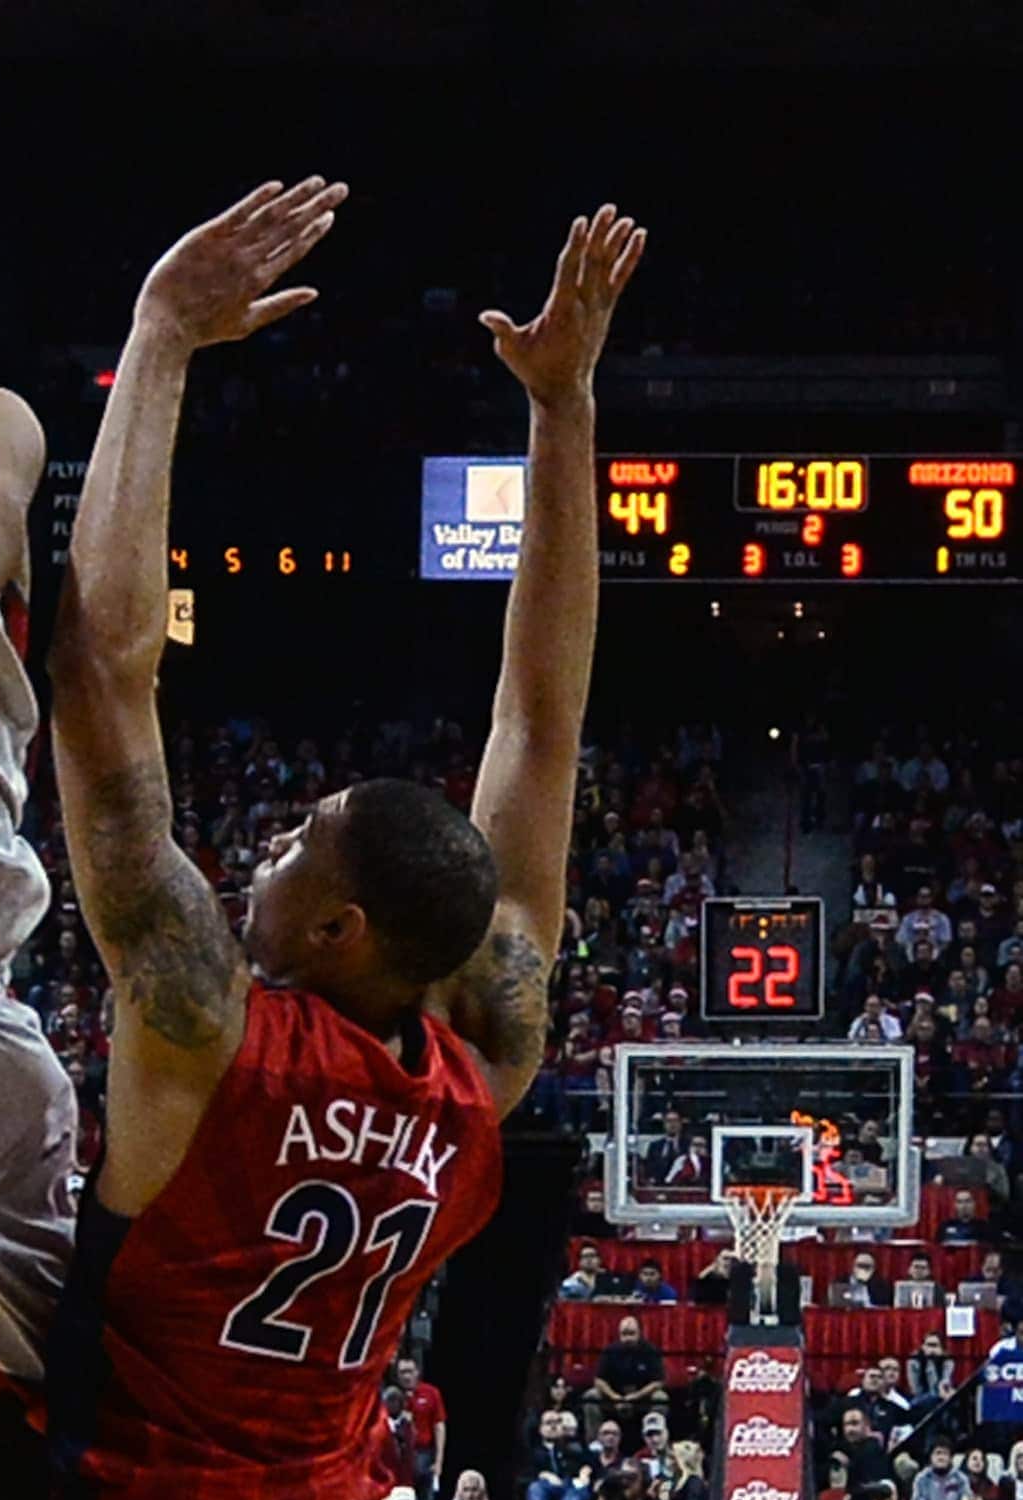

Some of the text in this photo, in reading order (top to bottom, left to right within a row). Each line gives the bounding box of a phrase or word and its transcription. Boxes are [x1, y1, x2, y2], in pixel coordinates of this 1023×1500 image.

[758, 462, 863, 510] 16:00
[909, 461, 1016, 486] ARIZONA
[609, 491, 668, 535] 44
[803, 513, 823, 546] 2
[945, 488, 1004, 540] 50
[433, 523, 497, 551] Valley
[171, 550, 188, 570] 4
[225, 547, 241, 573] 5
[279, 547, 296, 573] 6
[442, 547, 465, 570] of
[669, 543, 692, 576] 2
[743, 543, 765, 576] 3
[841, 543, 863, 576] 3
[936, 546, 949, 574] 1
[729, 946, 800, 1008] 22
[218, 1178, 440, 1371] 21
